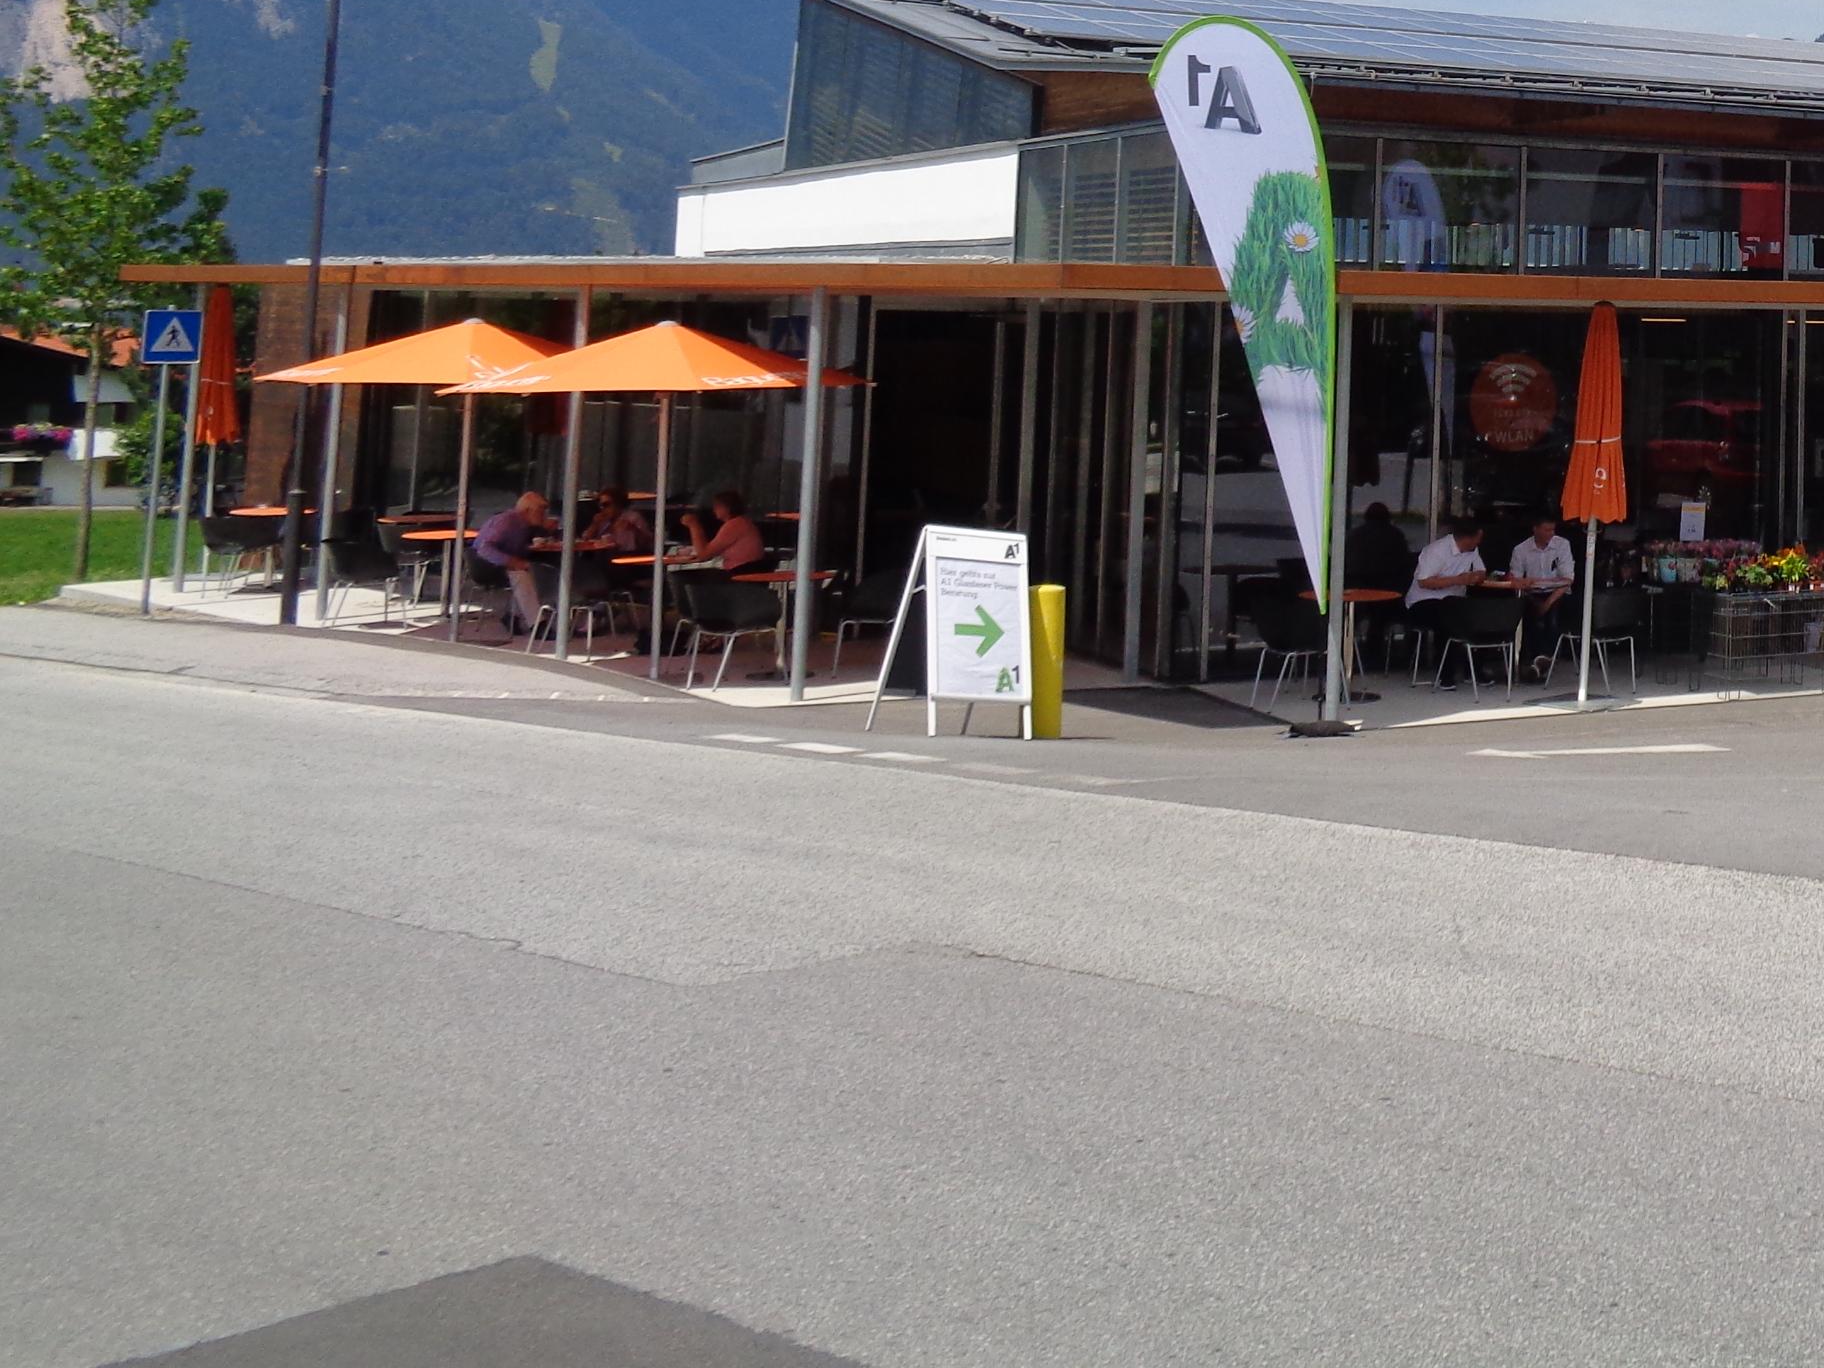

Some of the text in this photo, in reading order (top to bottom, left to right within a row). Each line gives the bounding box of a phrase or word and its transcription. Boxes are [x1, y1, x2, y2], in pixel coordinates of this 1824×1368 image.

[1495, 429, 1535, 443] WLAN
[1004, 543, 1019, 559] A1
[995, 665, 1019, 693] A1
